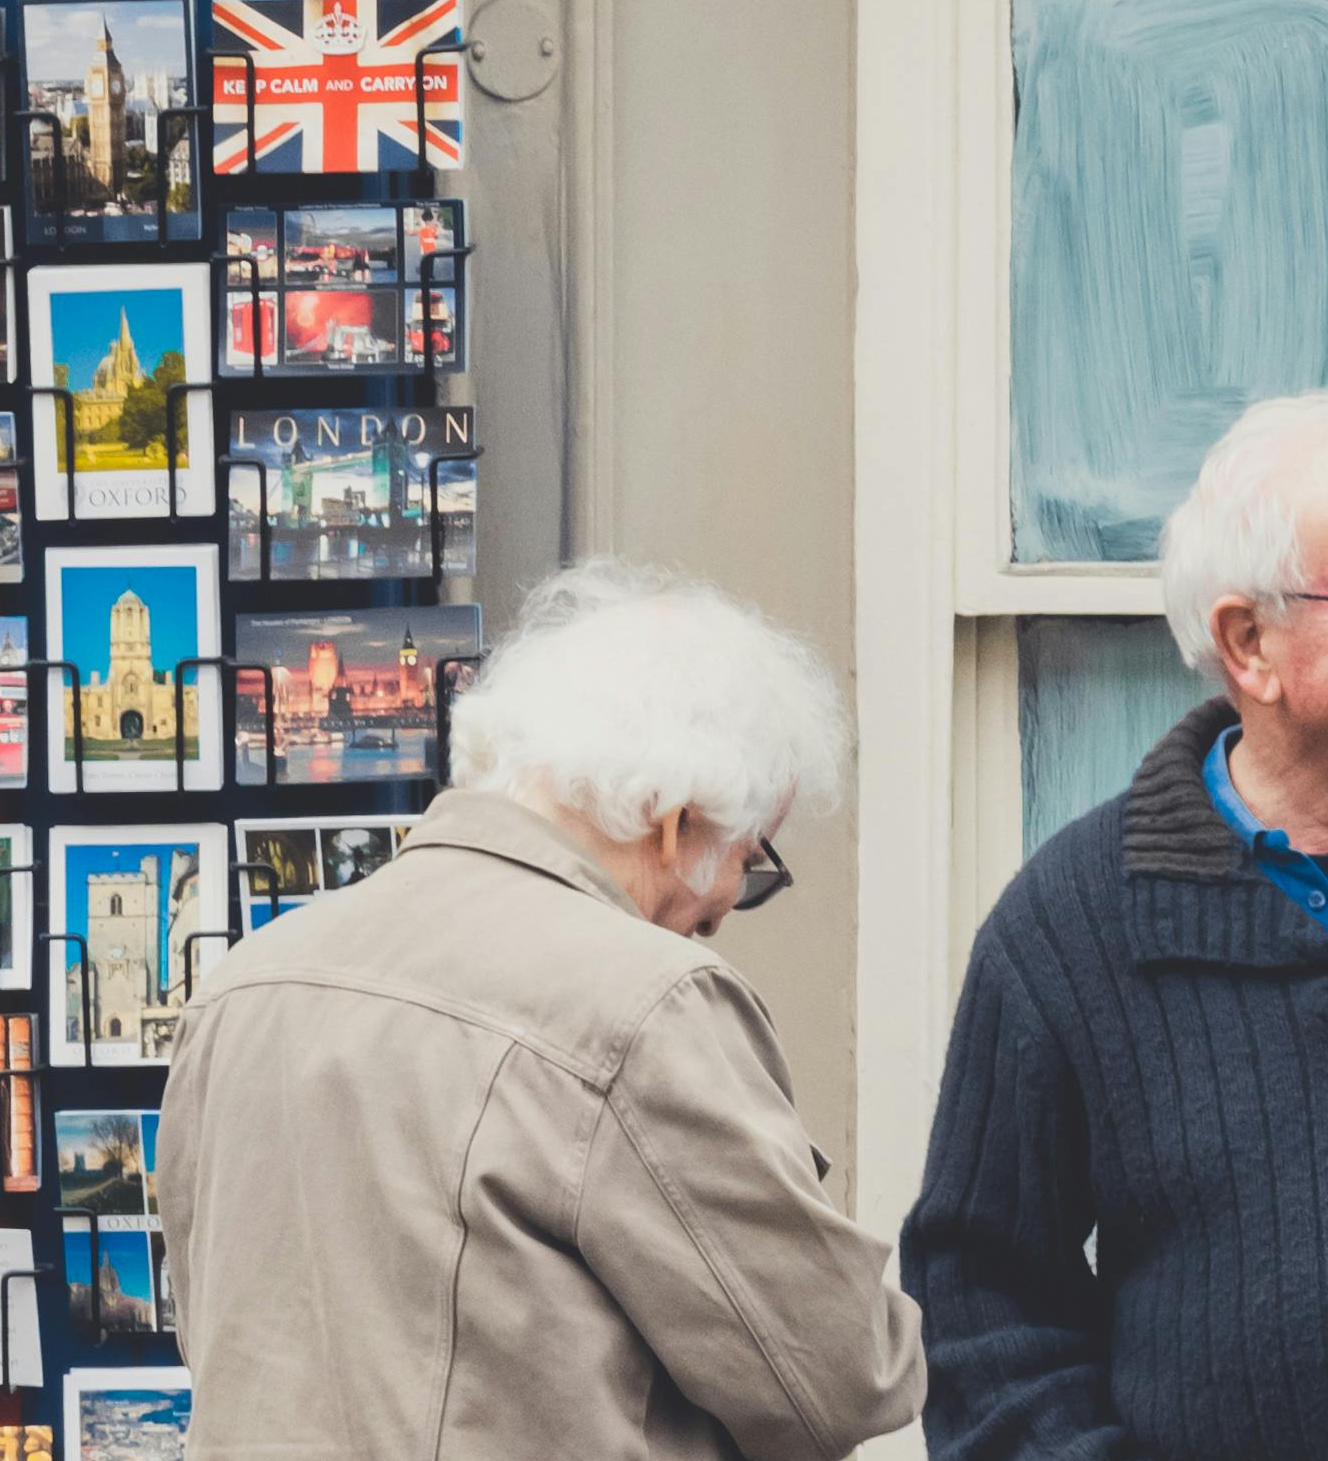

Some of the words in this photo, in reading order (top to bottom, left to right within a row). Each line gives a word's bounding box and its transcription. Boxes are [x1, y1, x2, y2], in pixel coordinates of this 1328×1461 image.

[223, 78, 266, 95] KEP
[270, 78, 319, 94] CALM
[326, 79, 354, 92] AND
[360, 76, 419, 93] CARRY
[422, 75, 448, 91] ON
[44, 225, 87, 236] LODON
[237, 412, 470, 449] LONDON
[106, 1216, 160, 1230] OXFO
